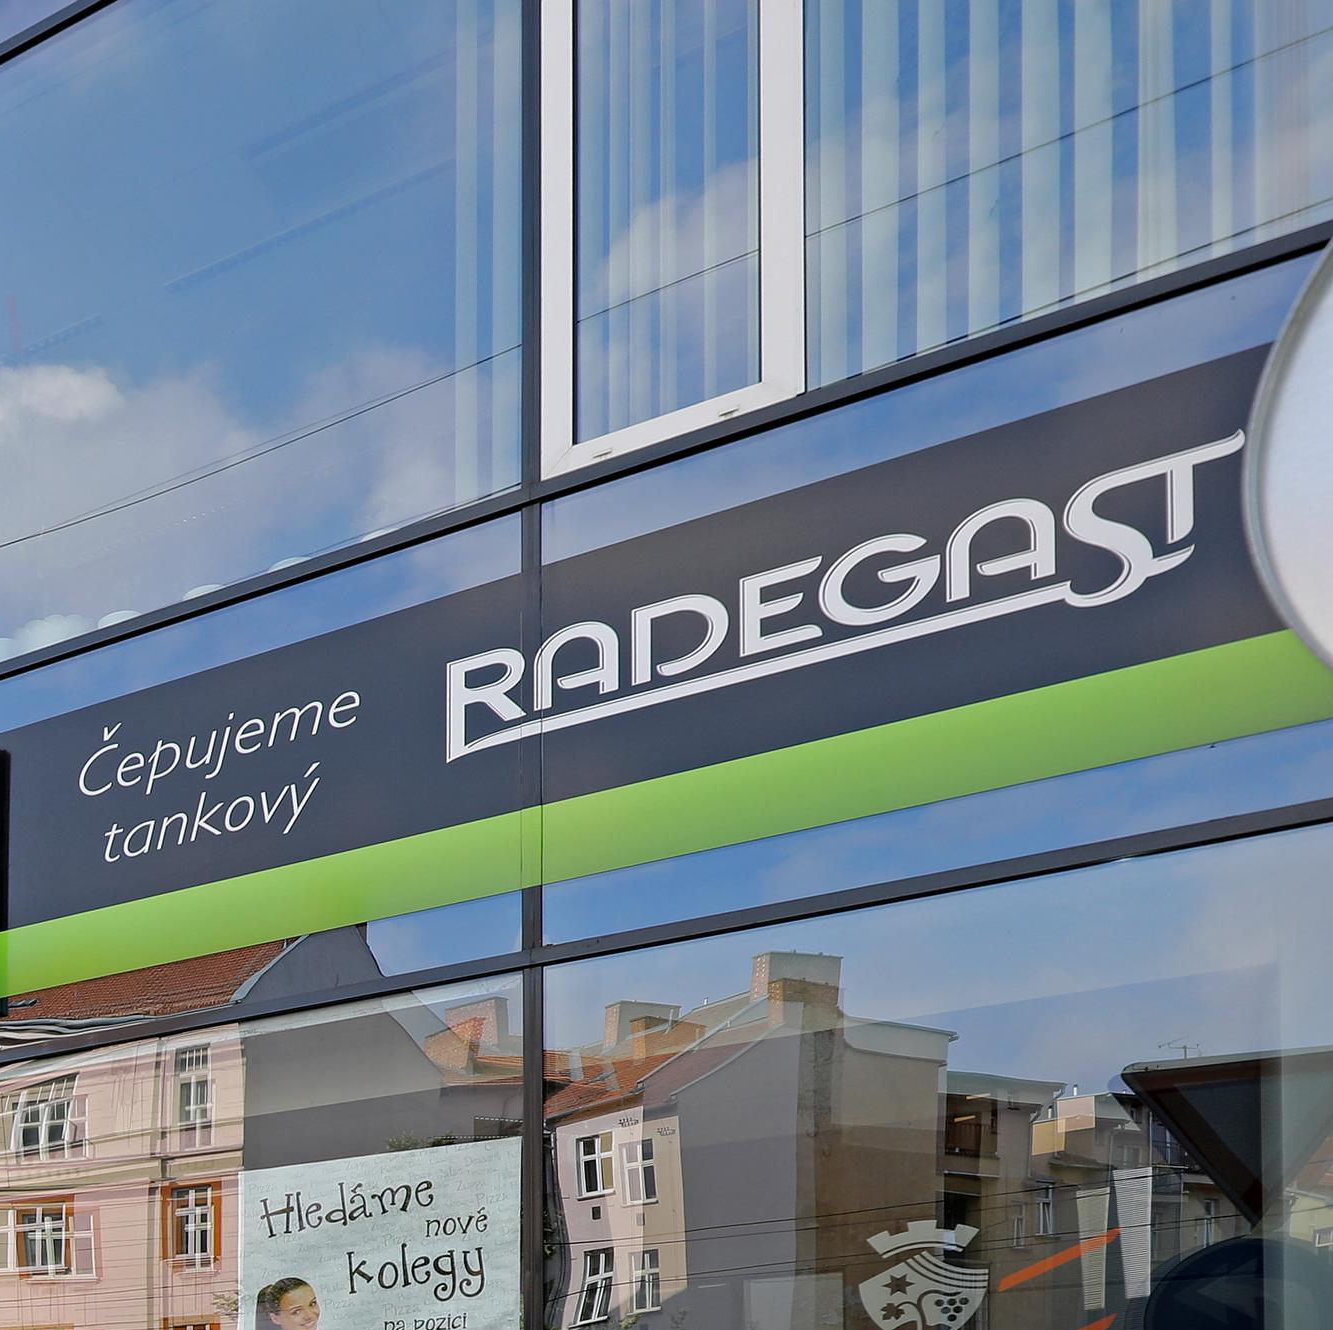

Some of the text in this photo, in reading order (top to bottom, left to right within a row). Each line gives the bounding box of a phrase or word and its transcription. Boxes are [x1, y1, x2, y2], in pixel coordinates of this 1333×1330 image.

[445, 429, 1246, 762] RADEGAST
[78, 687, 361, 799] Čepujeme
[102, 760, 322, 865] tankový
[260, 1179, 435, 1239] Hledáme
[425, 1206, 489, 1238] nové
[346, 1242, 486, 1302] kolegy
